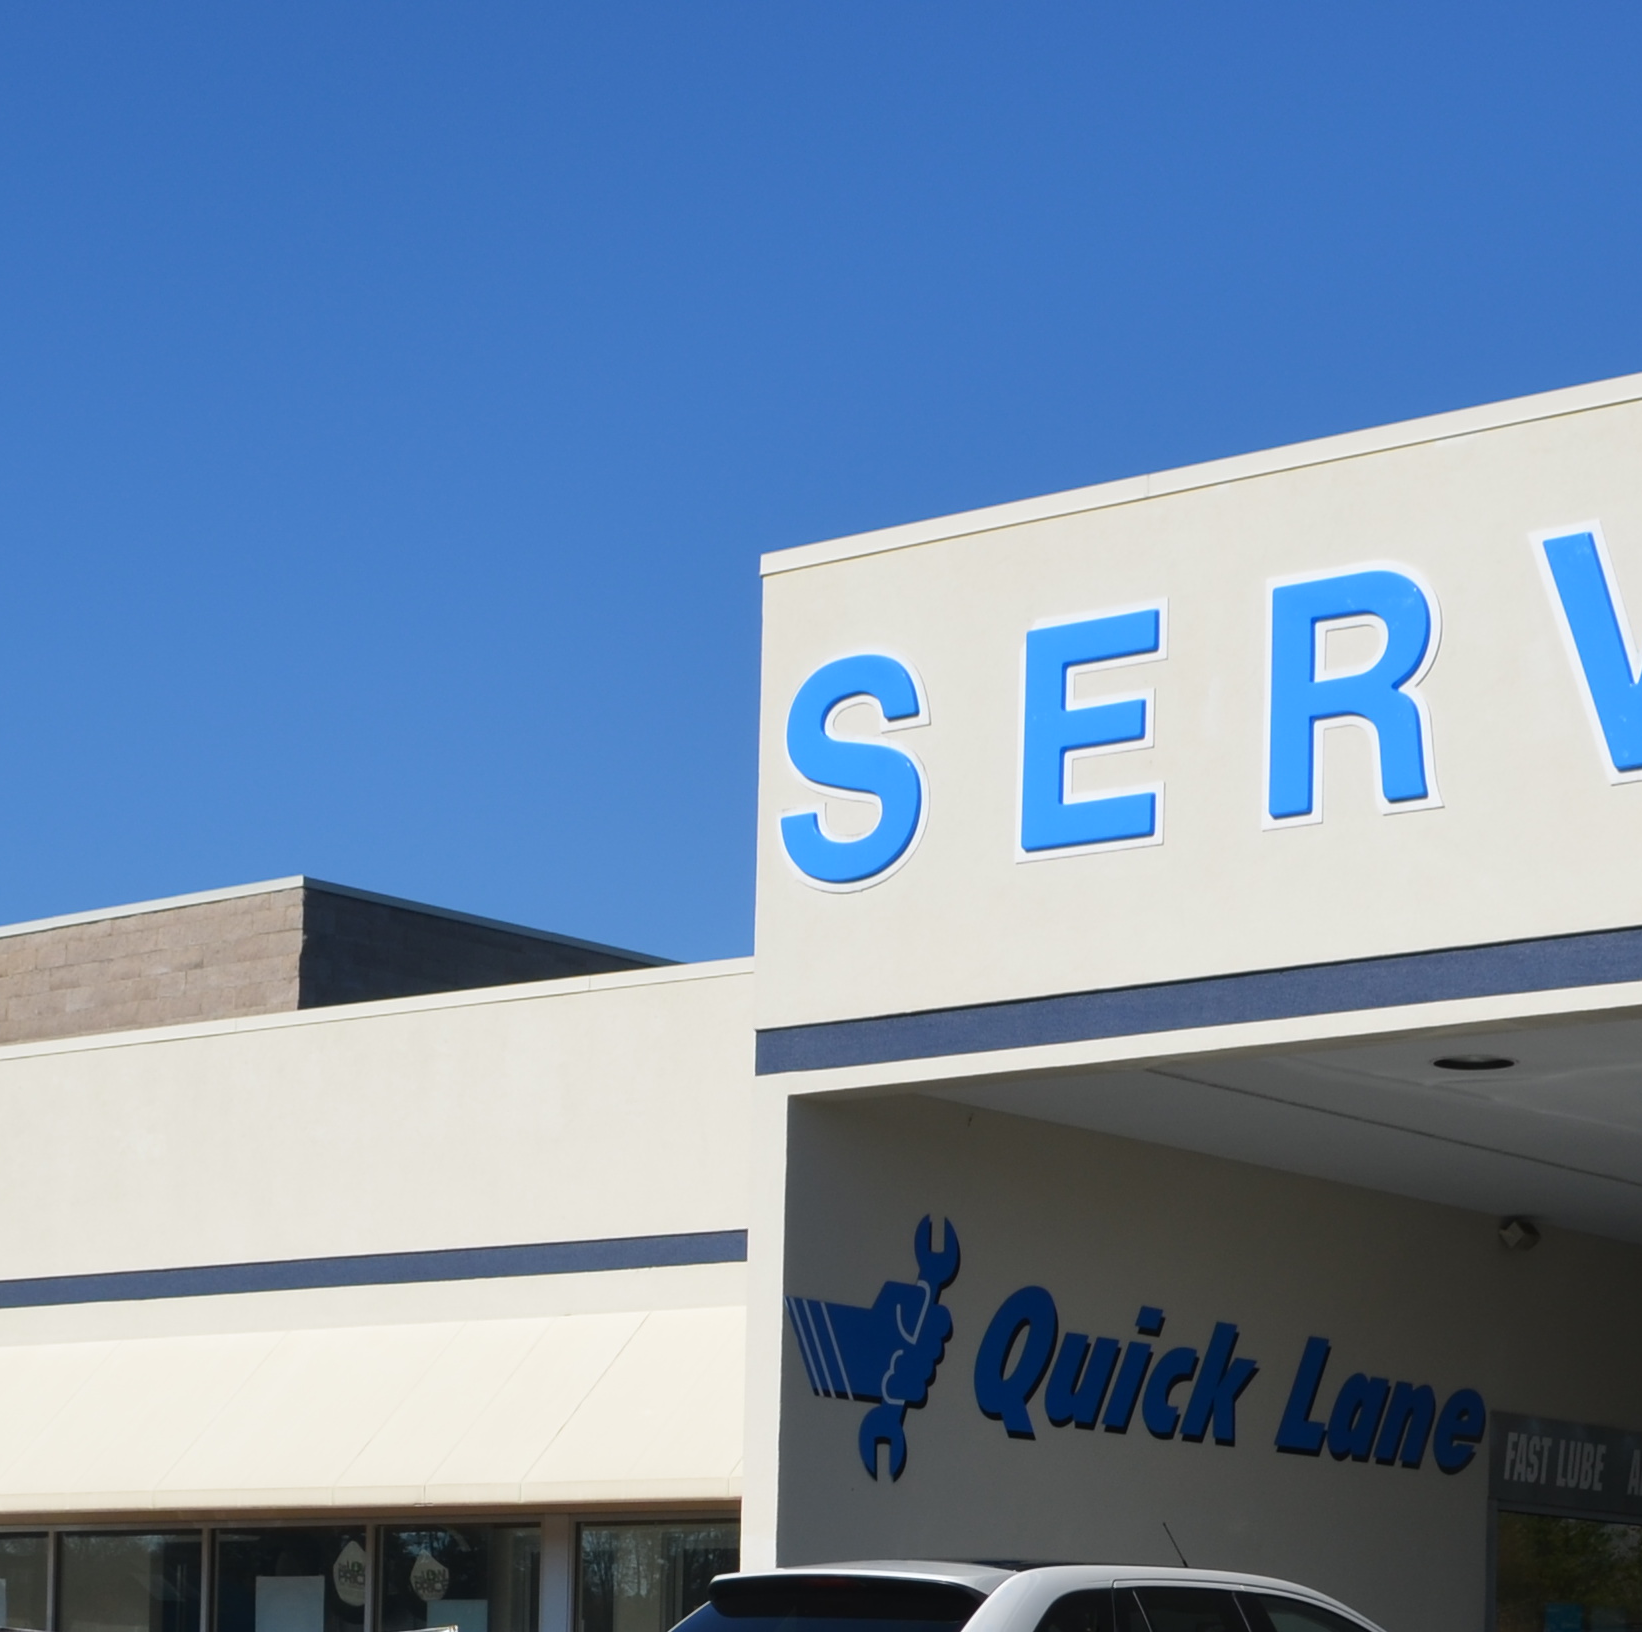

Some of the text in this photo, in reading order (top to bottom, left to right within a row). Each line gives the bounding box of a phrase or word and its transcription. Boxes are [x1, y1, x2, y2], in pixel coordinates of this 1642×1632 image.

[974, 1286, 1487, 1475] Quick Lane
[1504, 1432, 1552, 1485] FAST
[1556, 1439, 1606, 1491] LUBE
